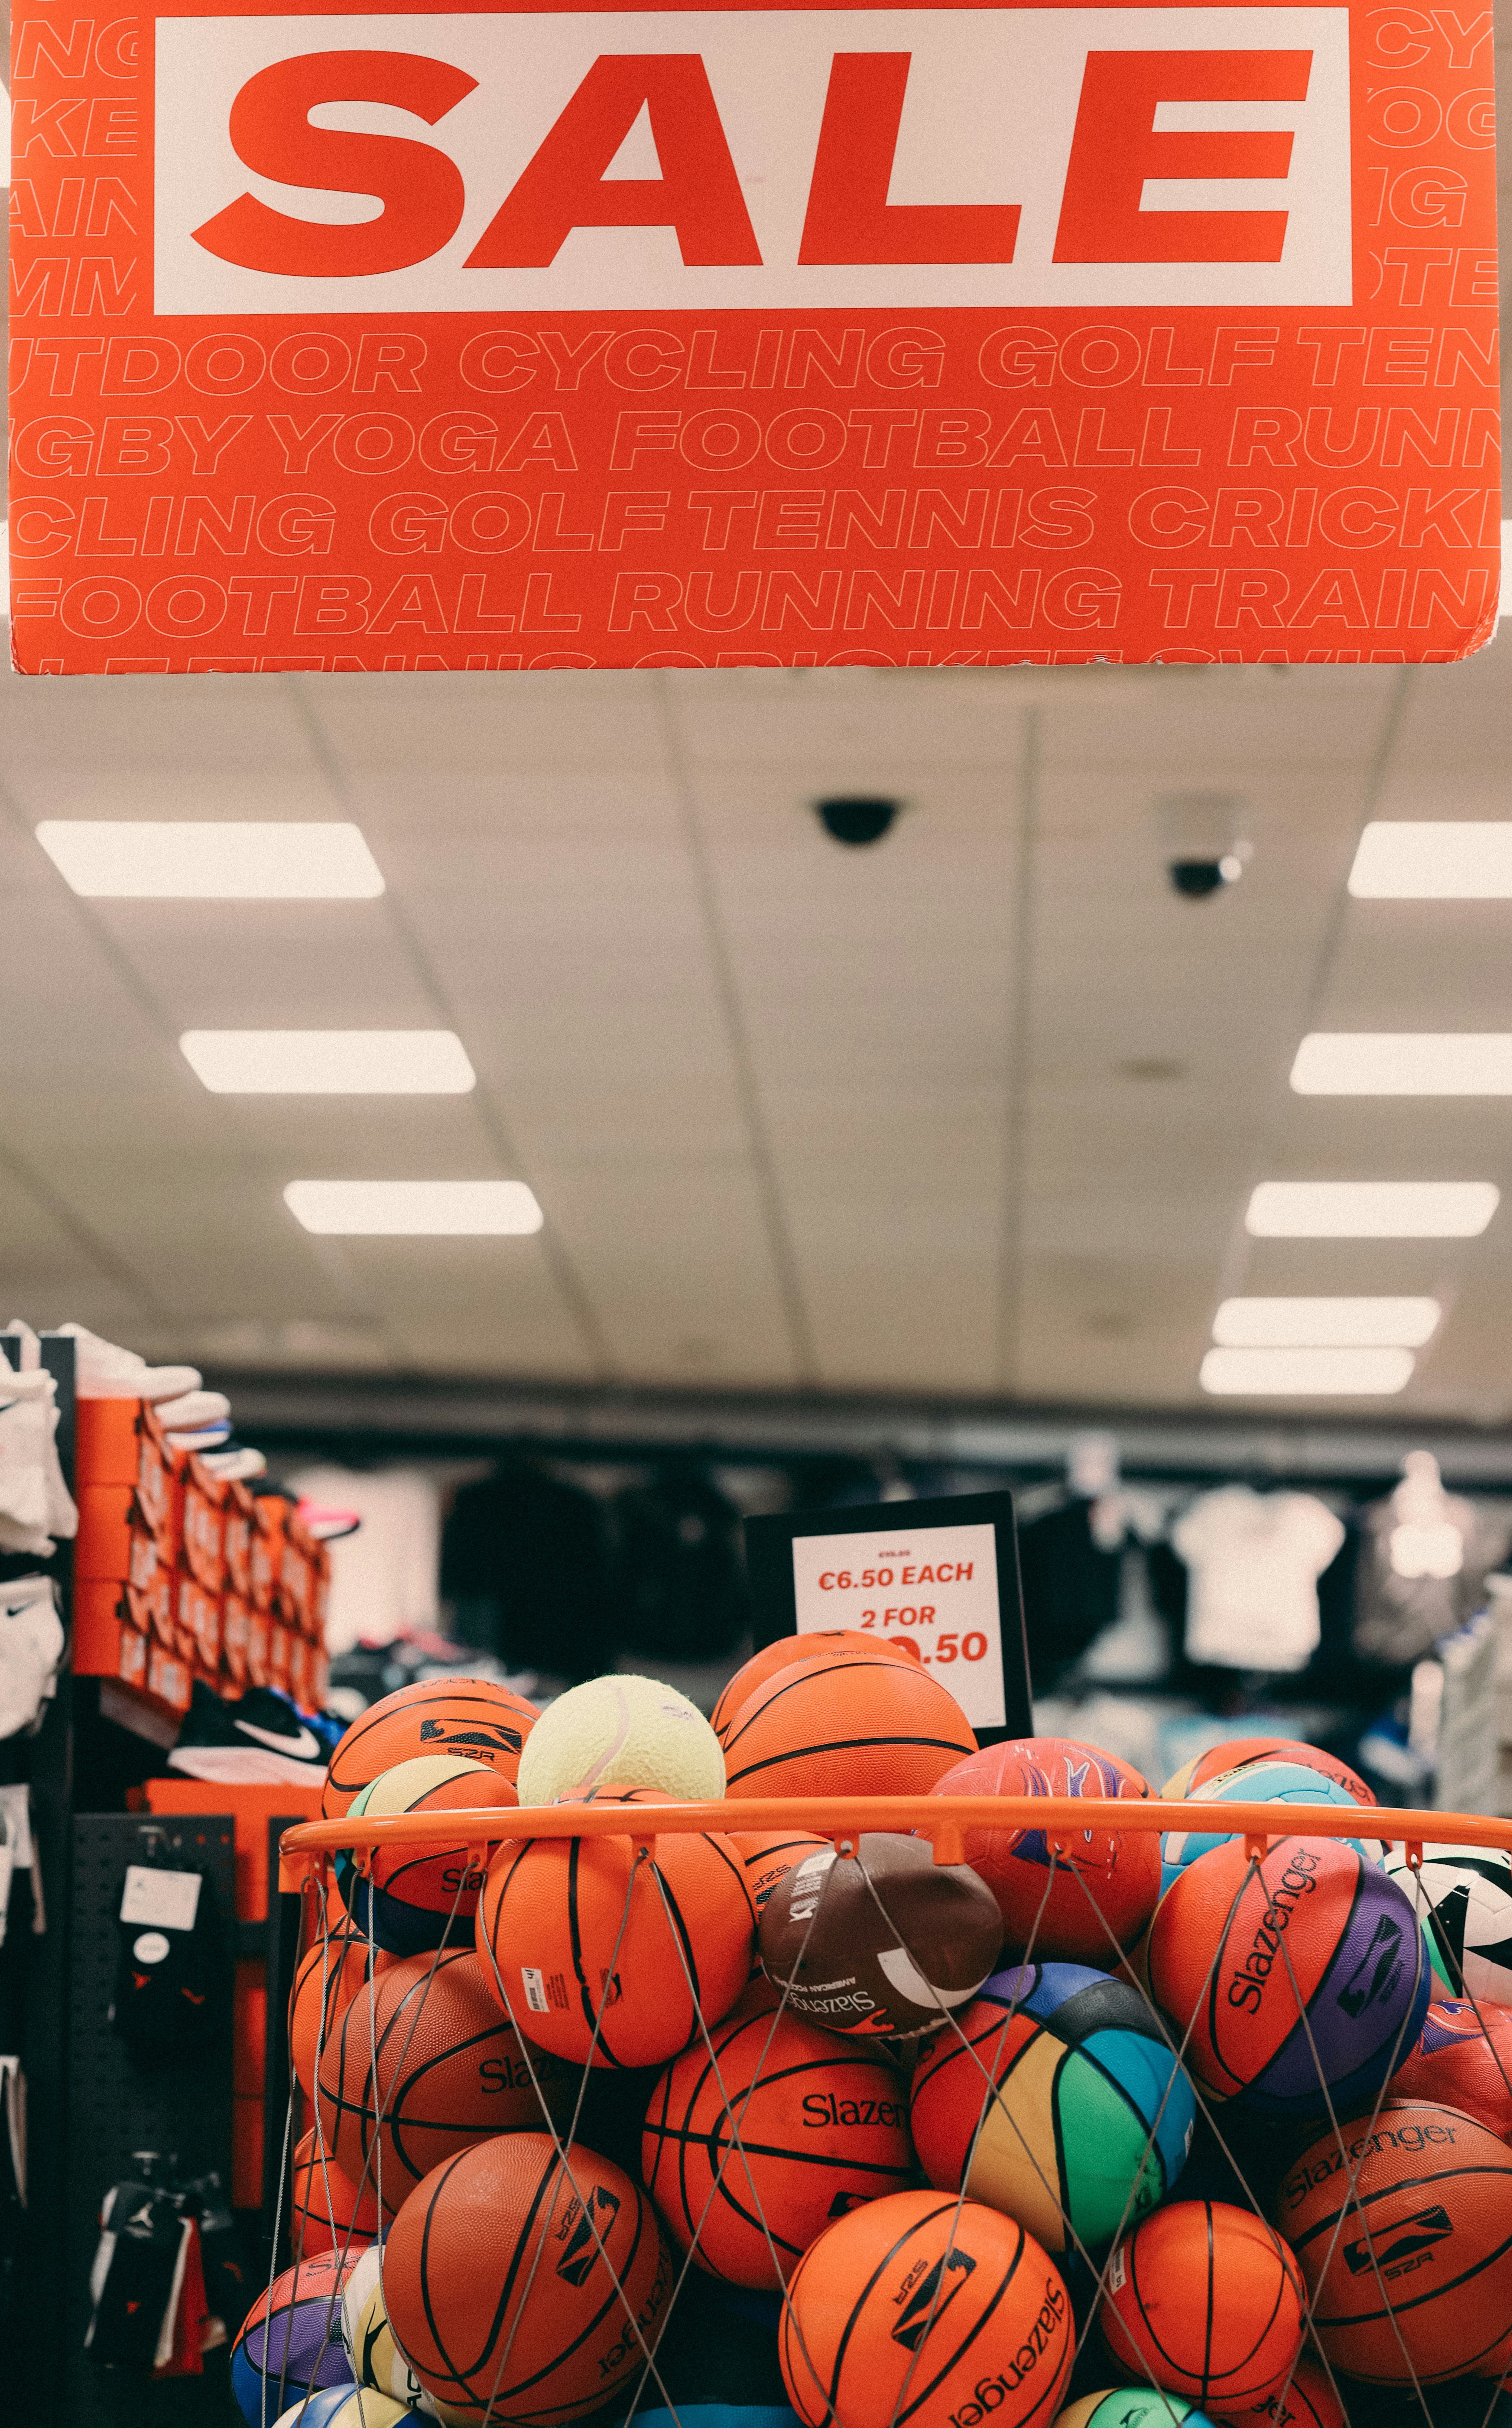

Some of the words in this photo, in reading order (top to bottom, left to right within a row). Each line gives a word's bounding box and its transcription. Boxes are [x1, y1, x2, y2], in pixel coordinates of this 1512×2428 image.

[10, 17, 138, 79] NG
[1367, 86, 1496, 150] OG
[190, 50, 1314, 277] SALE
[460, 327, 946, 393] CYCLING
[978, 325, 1280, 388] GOLF
[1297, 327, 1500, 388] TEN
[8, 415, 254, 479] GBY
[266, 411, 578, 475] YOGA
[609, 408, 1201, 471] FOOTBALL
[8, 496, 337, 559] CLING
[369, 491, 671, 555] GOLF
[687, 486, 1098, 550] TENNIS
[10, 573, 582, 639] FOOTBALL
[607, 567, 1123, 633] RUNNING
[819, 1568, 894, 1590] €6.50
[901, 1562, 974, 1585] EACH
[860, 1610, 876, 1628] 2
[883, 1606, 936, 1627] FOR
[1228, 1848, 1323, 2015] Slazenger
[791, 1991, 876, 2014] Slazeng
[807, 1977, 856, 1993] AMERICAN
[1285, 2124, 1456, 2210] Slazenger
[892, 2259, 929, 2306] SZR
[1384, 2252, 1434, 2281] SZR
